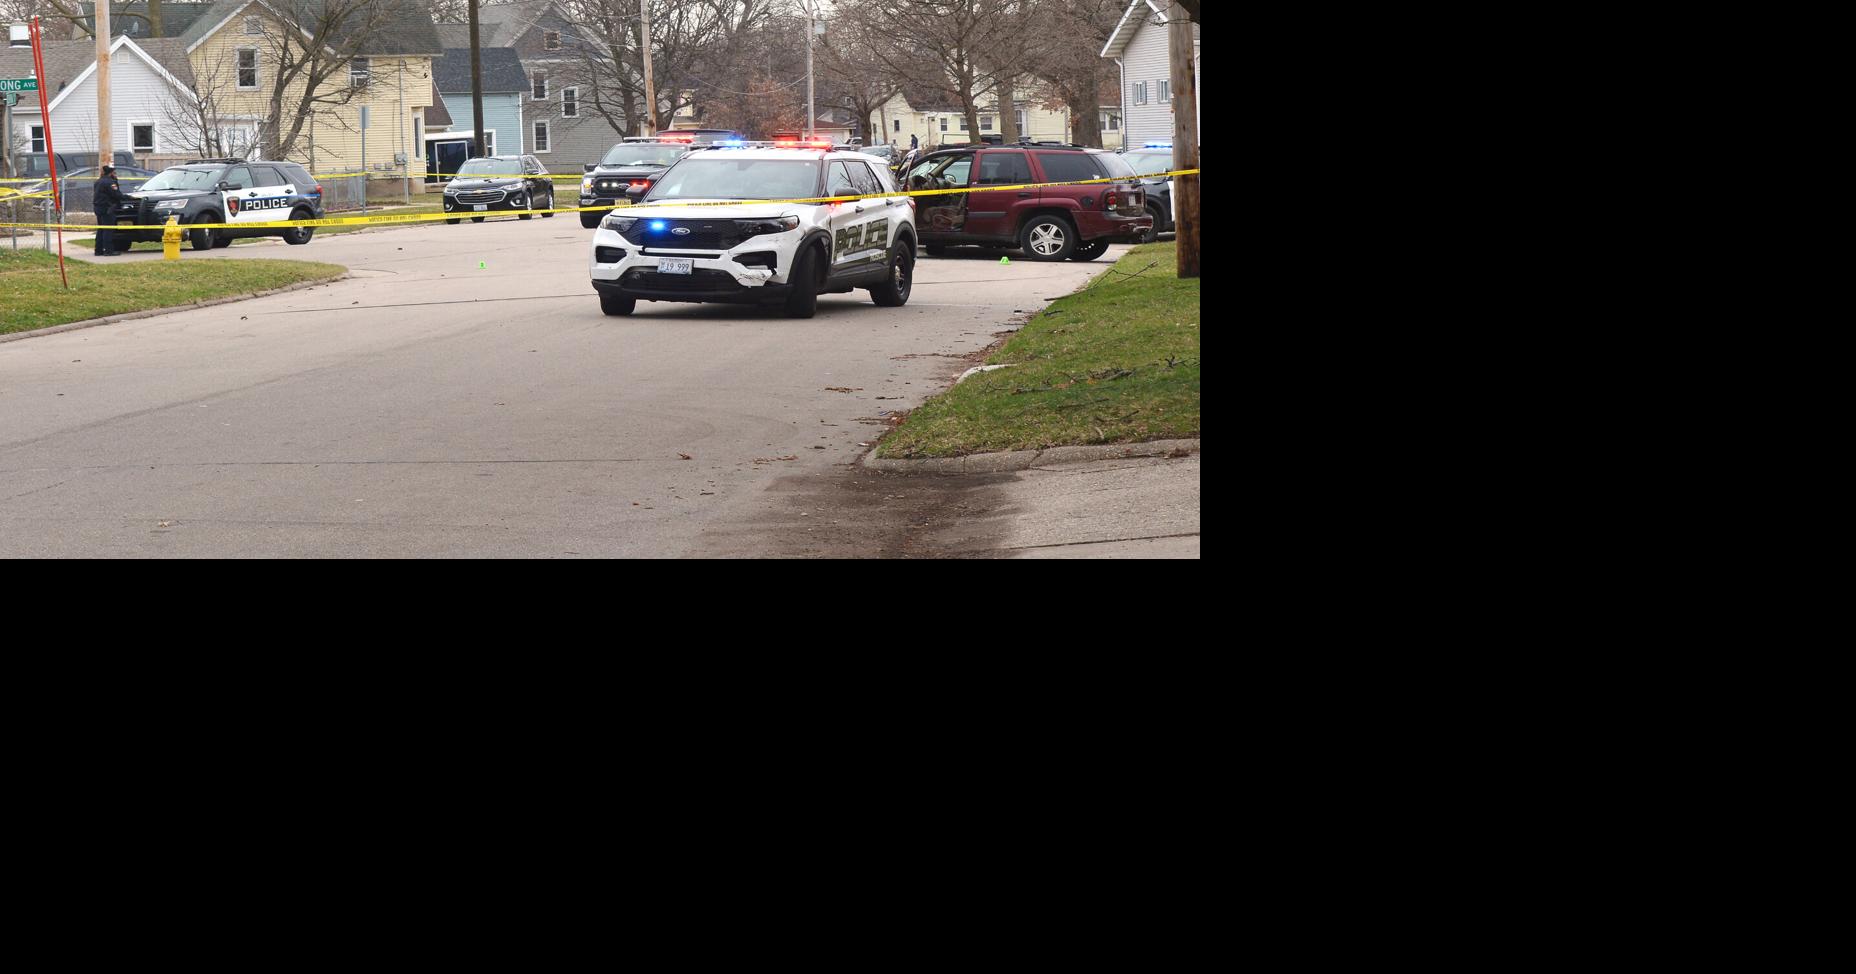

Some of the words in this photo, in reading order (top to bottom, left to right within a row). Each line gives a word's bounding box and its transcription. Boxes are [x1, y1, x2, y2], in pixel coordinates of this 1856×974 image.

[0, 80, 21, 91] ONG
[245, 198, 288, 210] POLICE
[833, 217, 888, 262] POLICE
